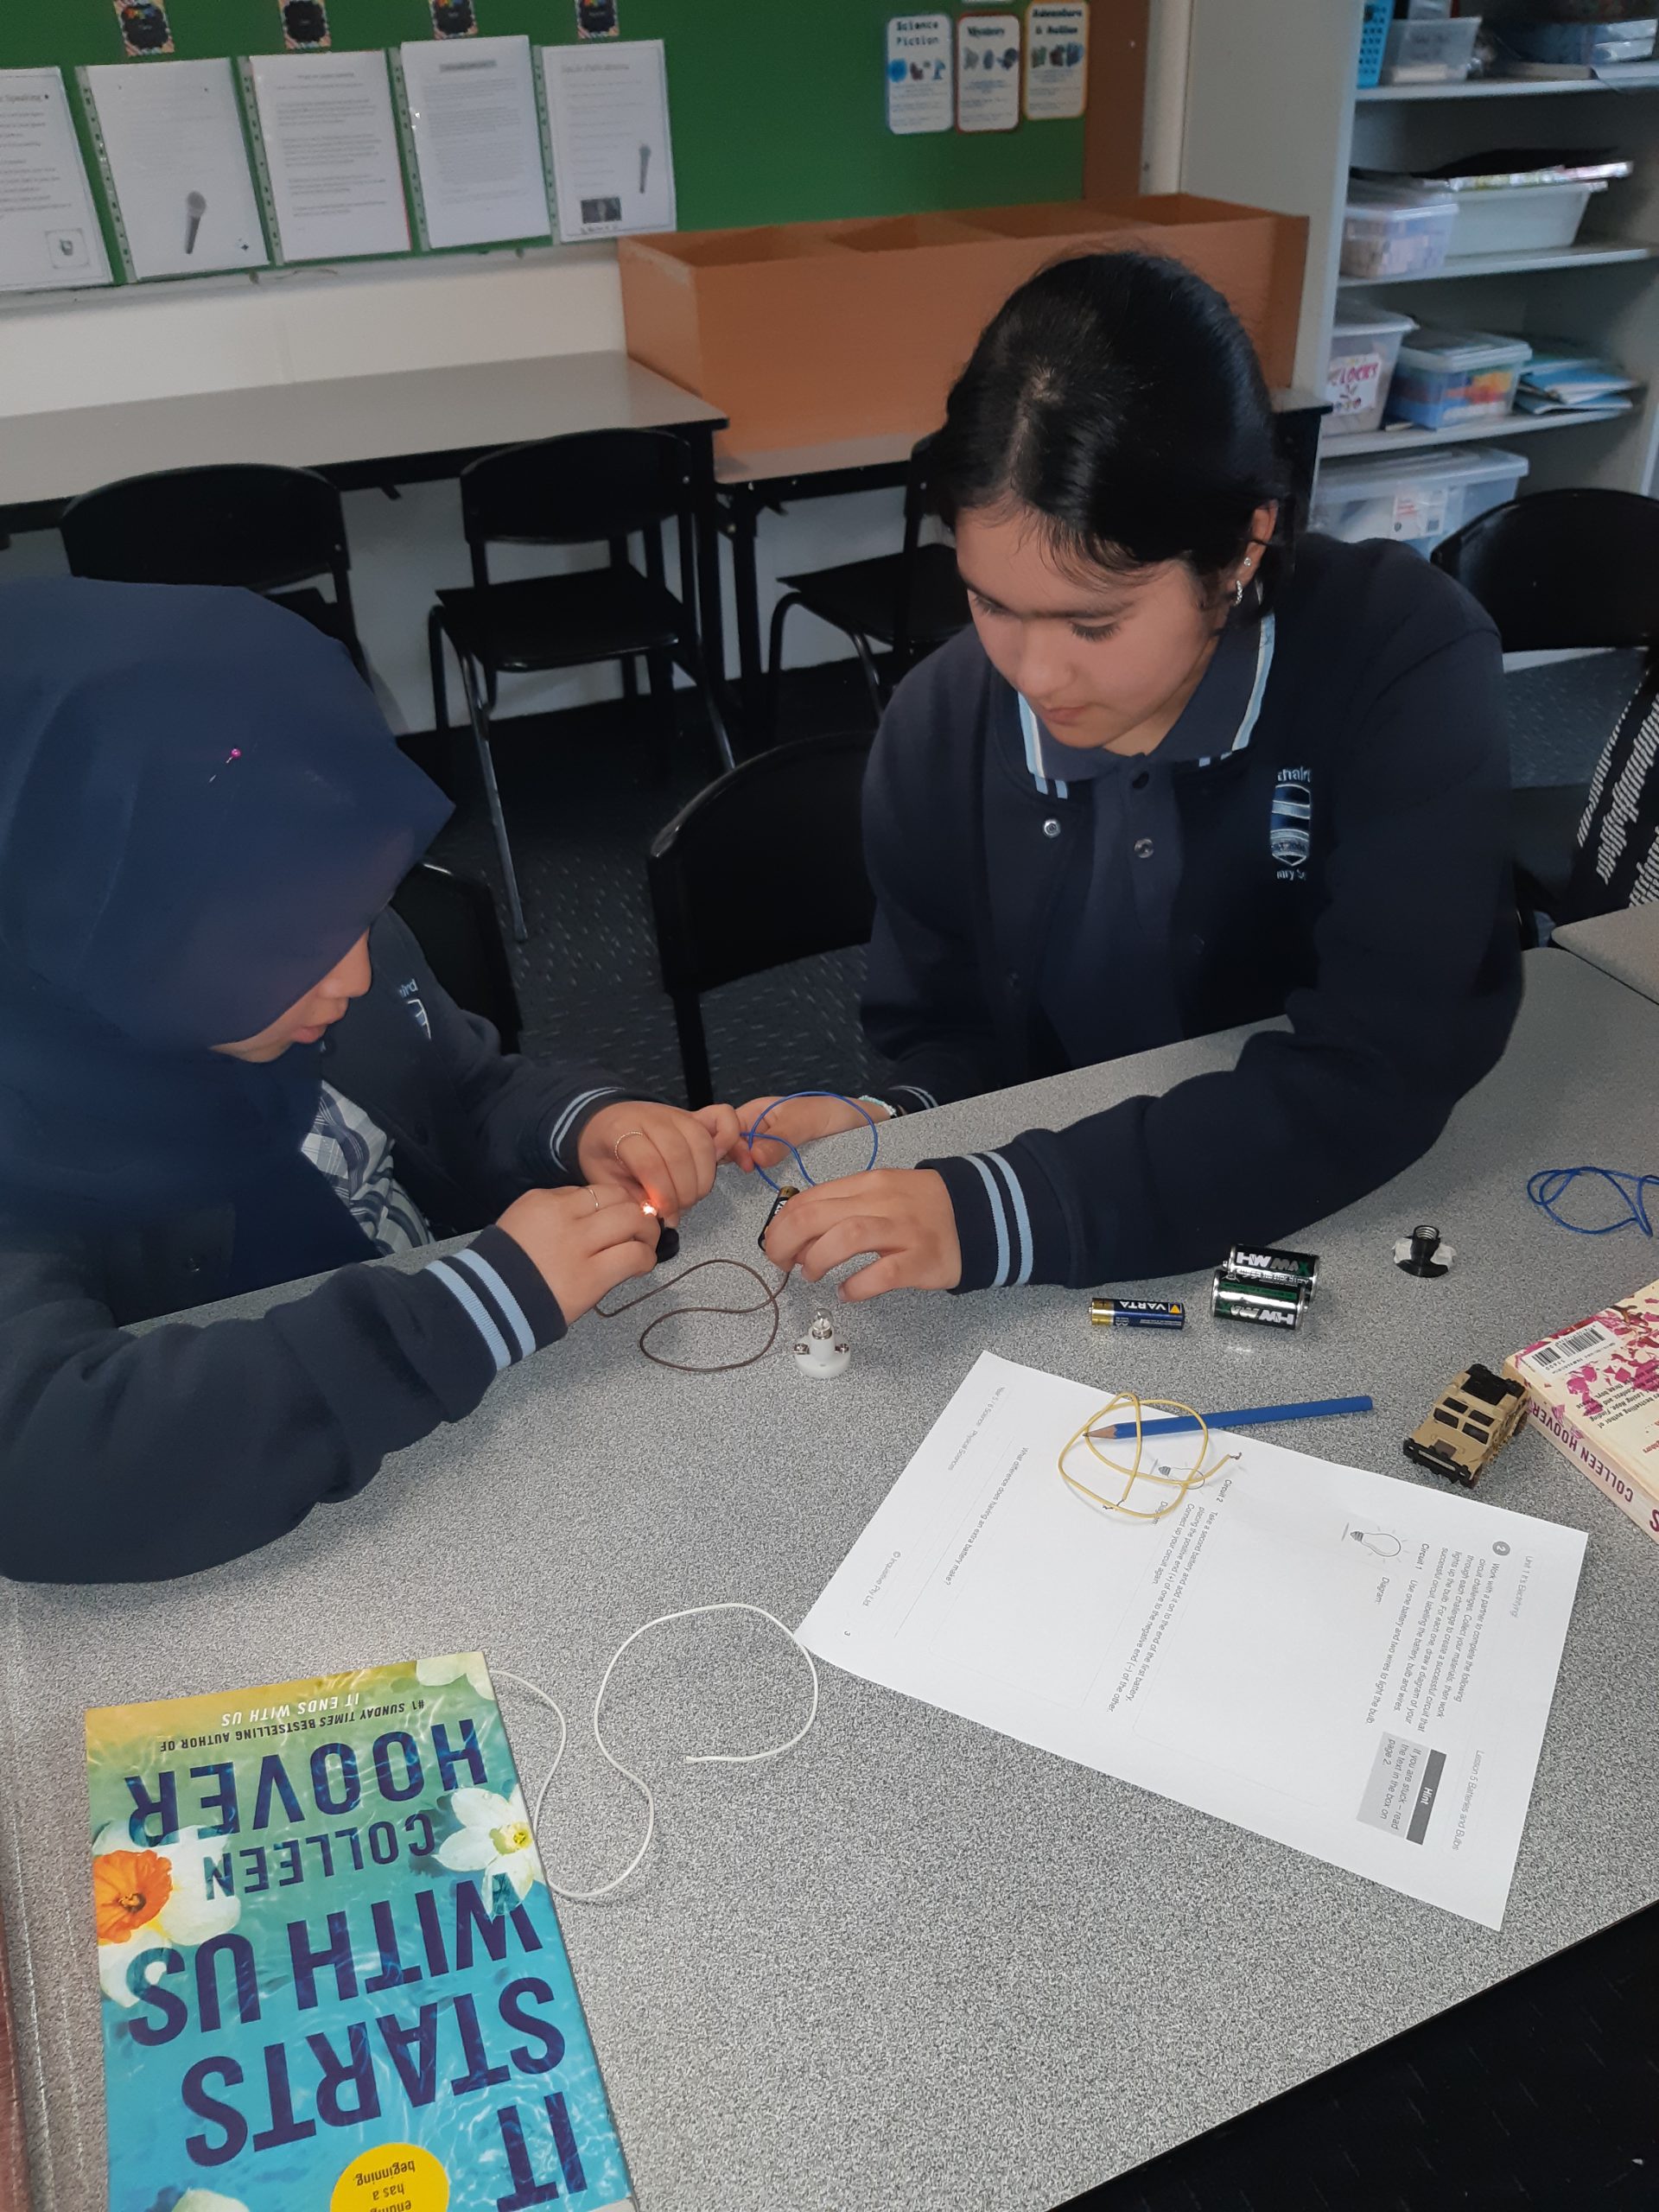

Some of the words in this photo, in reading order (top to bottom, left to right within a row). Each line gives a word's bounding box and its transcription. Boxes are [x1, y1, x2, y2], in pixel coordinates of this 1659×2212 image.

[896, 35, 939, 46] Fiction
[1269, 1258, 1310, 1275] MAX
[1120, 1301, 1166, 1311] VARTA
[1623, 1397, 1655, 1414] bestselling
[1625, 1392, 1644, 1403] Losing
[1589, 1408, 1611, 1422] Finding
[1605, 1412, 1624, 1424] author
[1532, 1402, 1578, 1452] HOOVER
[1015, 1446, 1028, 1461] What
[1001, 1460, 1019, 1486] difference
[1580, 1447, 1633, 1503] COLLEEN
[992, 1486, 1004, 1501] does
[1217, 1478, 1232, 1497] Circuit
[980, 1500, 997, 1520] having
[1178, 1503, 1195, 1528] Connect
[1205, 1511, 1218, 1525] Take
[967, 1528, 979, 1543] extra
[1168, 1535, 1179, 1548] your
[1193, 1529, 1208, 1552] second
[954, 1542, 972, 1565] battery
[1160, 1548, 1173, 1567] circuit
[1183, 1549, 1199, 1573] battery
[1416, 1542, 1429, 1565] Circuit
[1450, 1550, 1463, 1567] lights
[1433, 1547, 1451, 1580] successful
[1475, 1558, 1487, 1578] circuit
[1488, 1562, 1500, 1580] Work
[944, 1563, 959, 1586] make?
[1177, 1572, 1189, 1586] and
[1445, 1577, 1456, 1587] the
[1173, 1584, 1183, 1598] add
[1407, 1580, 1418, 1592] Use
[1484, 1580, 1493, 1593] with
[1402, 1592, 1412, 1605] one
[1395, 1605, 1409, 1627] battery
[1417, 1600, 1434, 1627] labelling
[1436, 1603, 1446, 1617] For
[1476, 1598, 1488, 1622] partner
[1158, 1619, 1168, 1630] the
[1415, 1626, 1427, 1637] the
[1431, 1616, 1445, 1632] each
[1458, 1613, 1472, 1636] Collect
[1152, 1630, 1162, 1644] end
[1392, 1627, 1402, 1641] and
[1388, 1640, 1398, 1653] two
[1452, 1635, 1464, 1651] your
[1465, 1628, 1480, 1660] complete
[1143, 1651, 1154, 1662] the
[1382, 1654, 1393, 1671] wires
[1422, 1648, 1433, 1665] draw
[1136, 1662, 1149, 1676] first
[1403, 1662, 1416, 1678] bulb
[1463, 1659, 1472, 1672] the
[1374, 1679, 1387, 1695] light
[1399, 1677, 1411, 1693] and
[1412, 1669, 1427, 1700] diagram
[1440, 1684, 1452, 1700] then
[1452, 1669, 1471, 1702] following
[297, 1696, 338, 1714] ENDS
[345, 1692, 359, 1707] IT
[411, 1700, 425, 1710] #1
[1370, 1694, 1381, 1707] the
[250, 1704, 290, 1723] WITH
[359, 1703, 404, 1720] SUNDAY
[1404, 1706, 1415, 1724] your
[1435, 1700, 1446, 1718] work
[221, 1711, 242, 1726] US
[319, 1711, 355, 1727] TIMES
[235, 1719, 315, 1741] BESTSELLING
[160, 1740, 175, 1752] OF
[181, 1732, 230, 1749] AUTHOR
[1382, 1737, 1395, 1758] page
[1397, 1742, 1409, 1758] the
[1394, 1756, 1406, 1772] text
[1407, 1752, 1418, 1770] you
[124, 1719, 488, 1848] HOOVER
[1404, 1769, 1414, 1782] are
[1387, 1779, 1399, 1792] the
[1397, 1782, 1409, 1804] stuck
[1382, 1792, 1395, 1808] box
[1419, 1786, 1433, 1806] Hint
[1390, 1810, 1402, 1831] read
[202, 1813, 435, 1900] COLLEEN
[287, 1873, 543, 2011] WITH
[125, 1933, 261, 2046] US
[181, 1977, 566, 2167] STARTS
[497, 2092, 588, 2212] IT
[353, 2160, 415, 2187] beginning.
[372, 2190, 379, 2201] a
[383, 2183, 404, 2198] has
